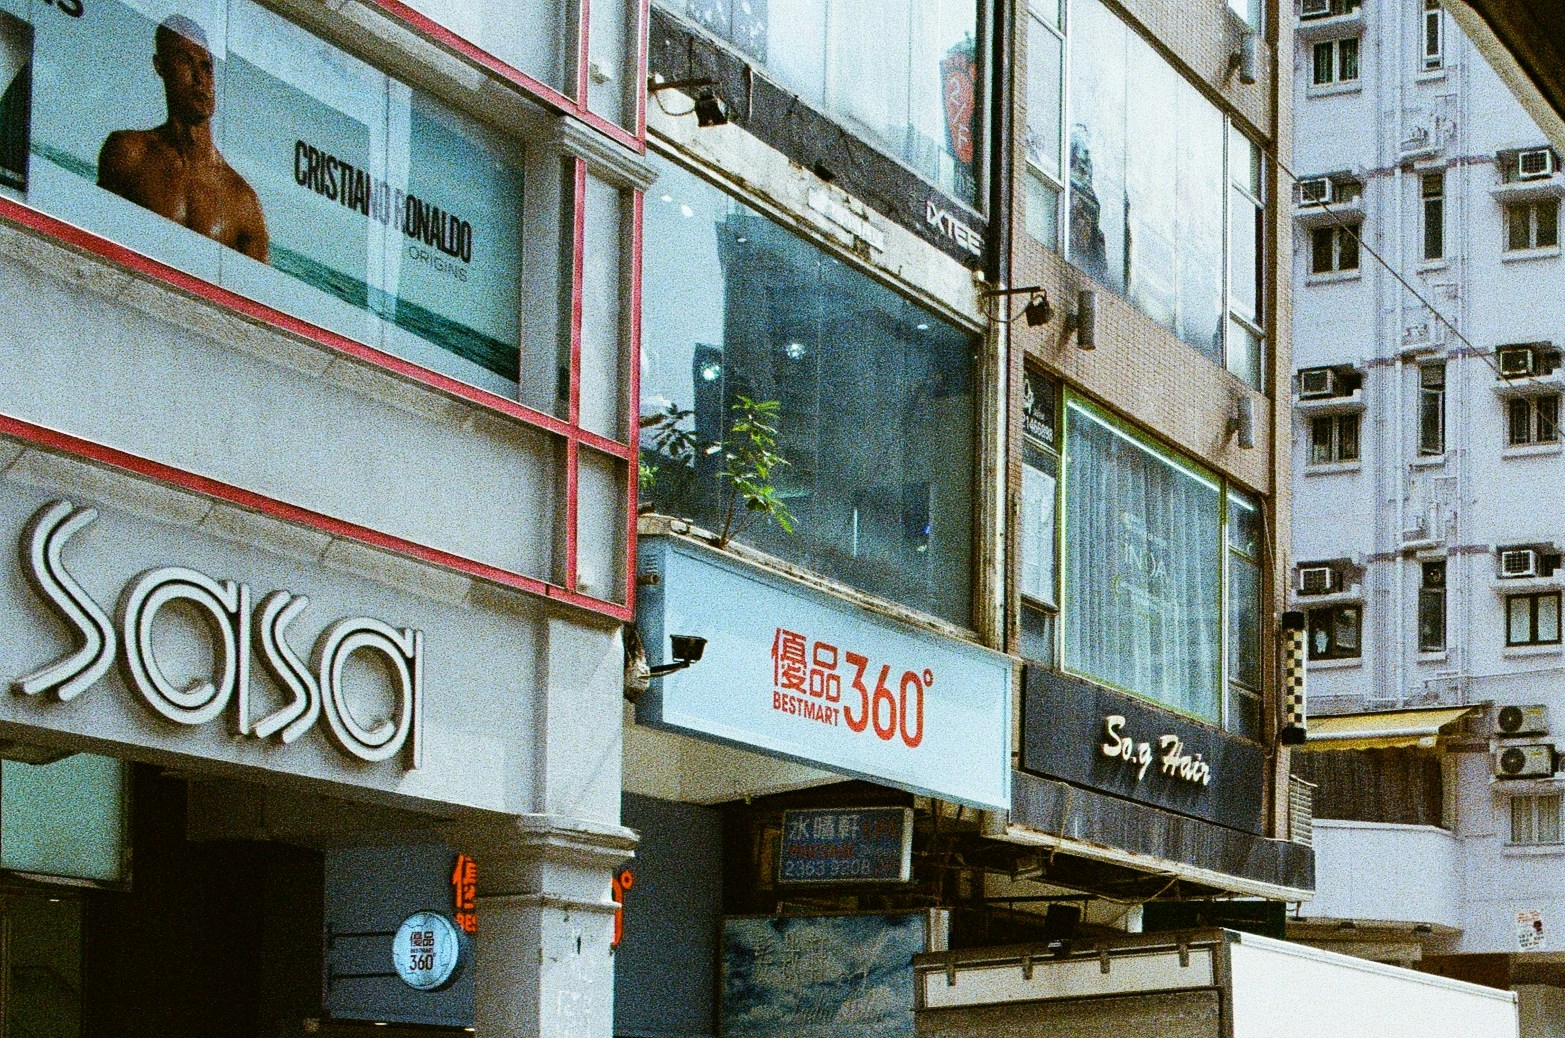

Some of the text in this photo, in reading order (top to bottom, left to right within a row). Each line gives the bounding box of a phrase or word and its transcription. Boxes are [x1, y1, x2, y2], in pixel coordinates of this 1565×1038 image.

[294, 139, 472, 265] CRISTIANO RONALDO
[409, 244, 469, 283] ORIGINS
[771, 627, 841, 705] 優品
[773, 692, 841, 728] BESTMART
[1160, 733, 1212, 788] Hair
